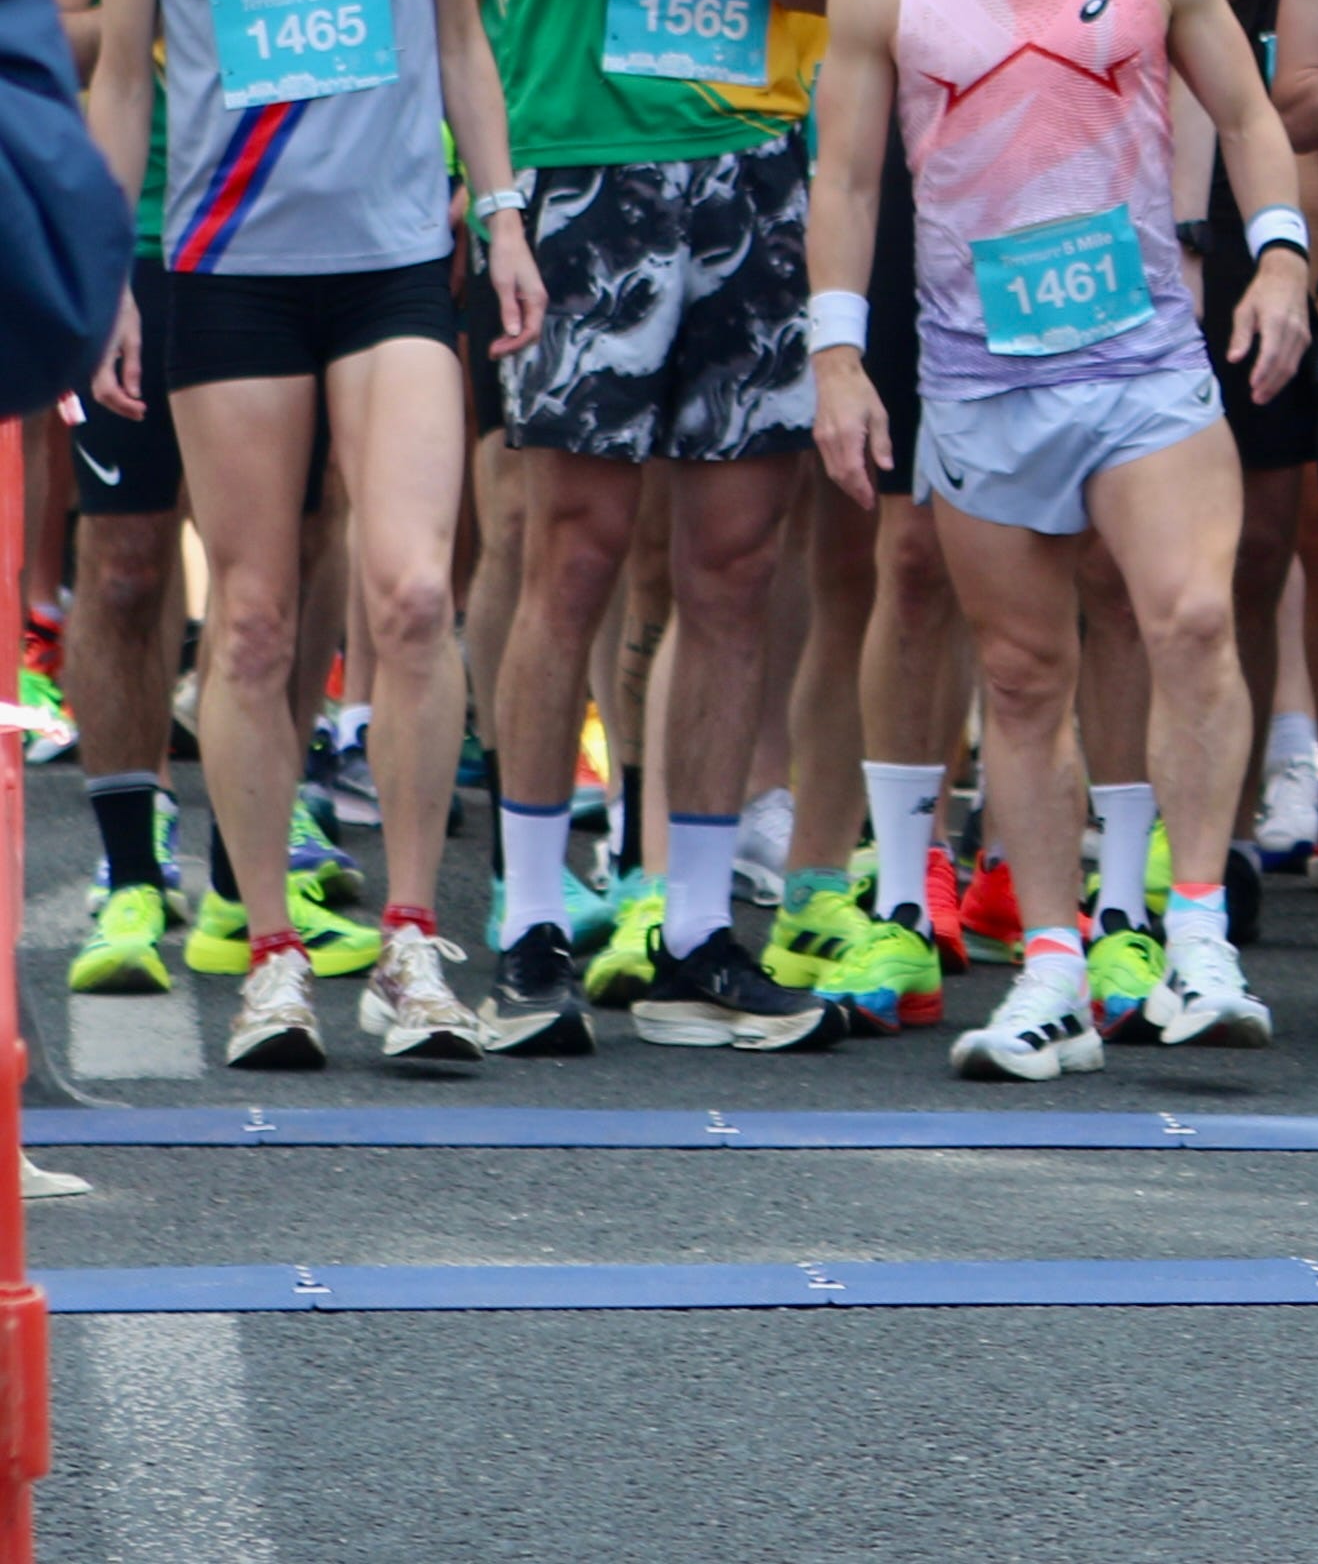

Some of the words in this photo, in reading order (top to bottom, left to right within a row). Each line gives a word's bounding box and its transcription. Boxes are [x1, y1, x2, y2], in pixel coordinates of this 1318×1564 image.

[246, 3, 368, 61] 1465
[1076, 232, 1113, 252] Mile
[1007, 253, 1117, 315] 1461
